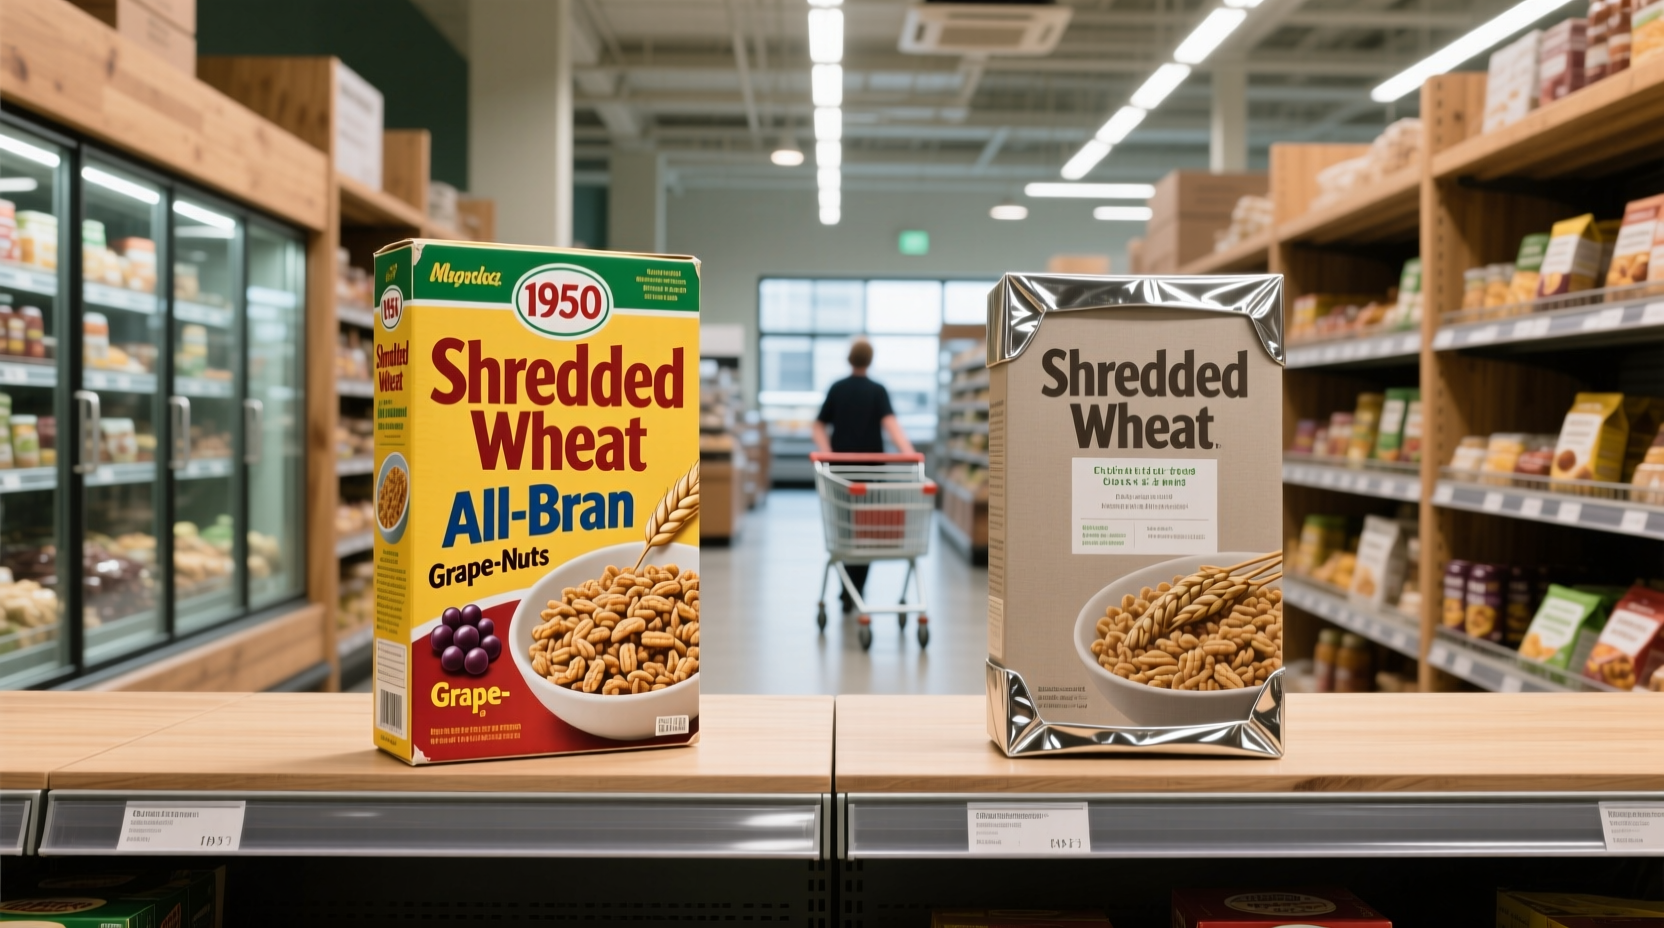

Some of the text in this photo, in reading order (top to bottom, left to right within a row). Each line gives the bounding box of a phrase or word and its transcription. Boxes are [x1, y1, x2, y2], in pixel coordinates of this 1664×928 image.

[525, 282, 602, 319] 1950
[430, 337, 684, 409] Shredded
[1041, 348, 1248, 398] Shredded
[470, 410, 647, 472] Wheat
[1070, 402, 1214, 450] Wheat
[442, 483, 634, 548] All-Bran
[428, 546, 549, 589] Grape-Nuts
[430, 681, 510, 714] Grape-
